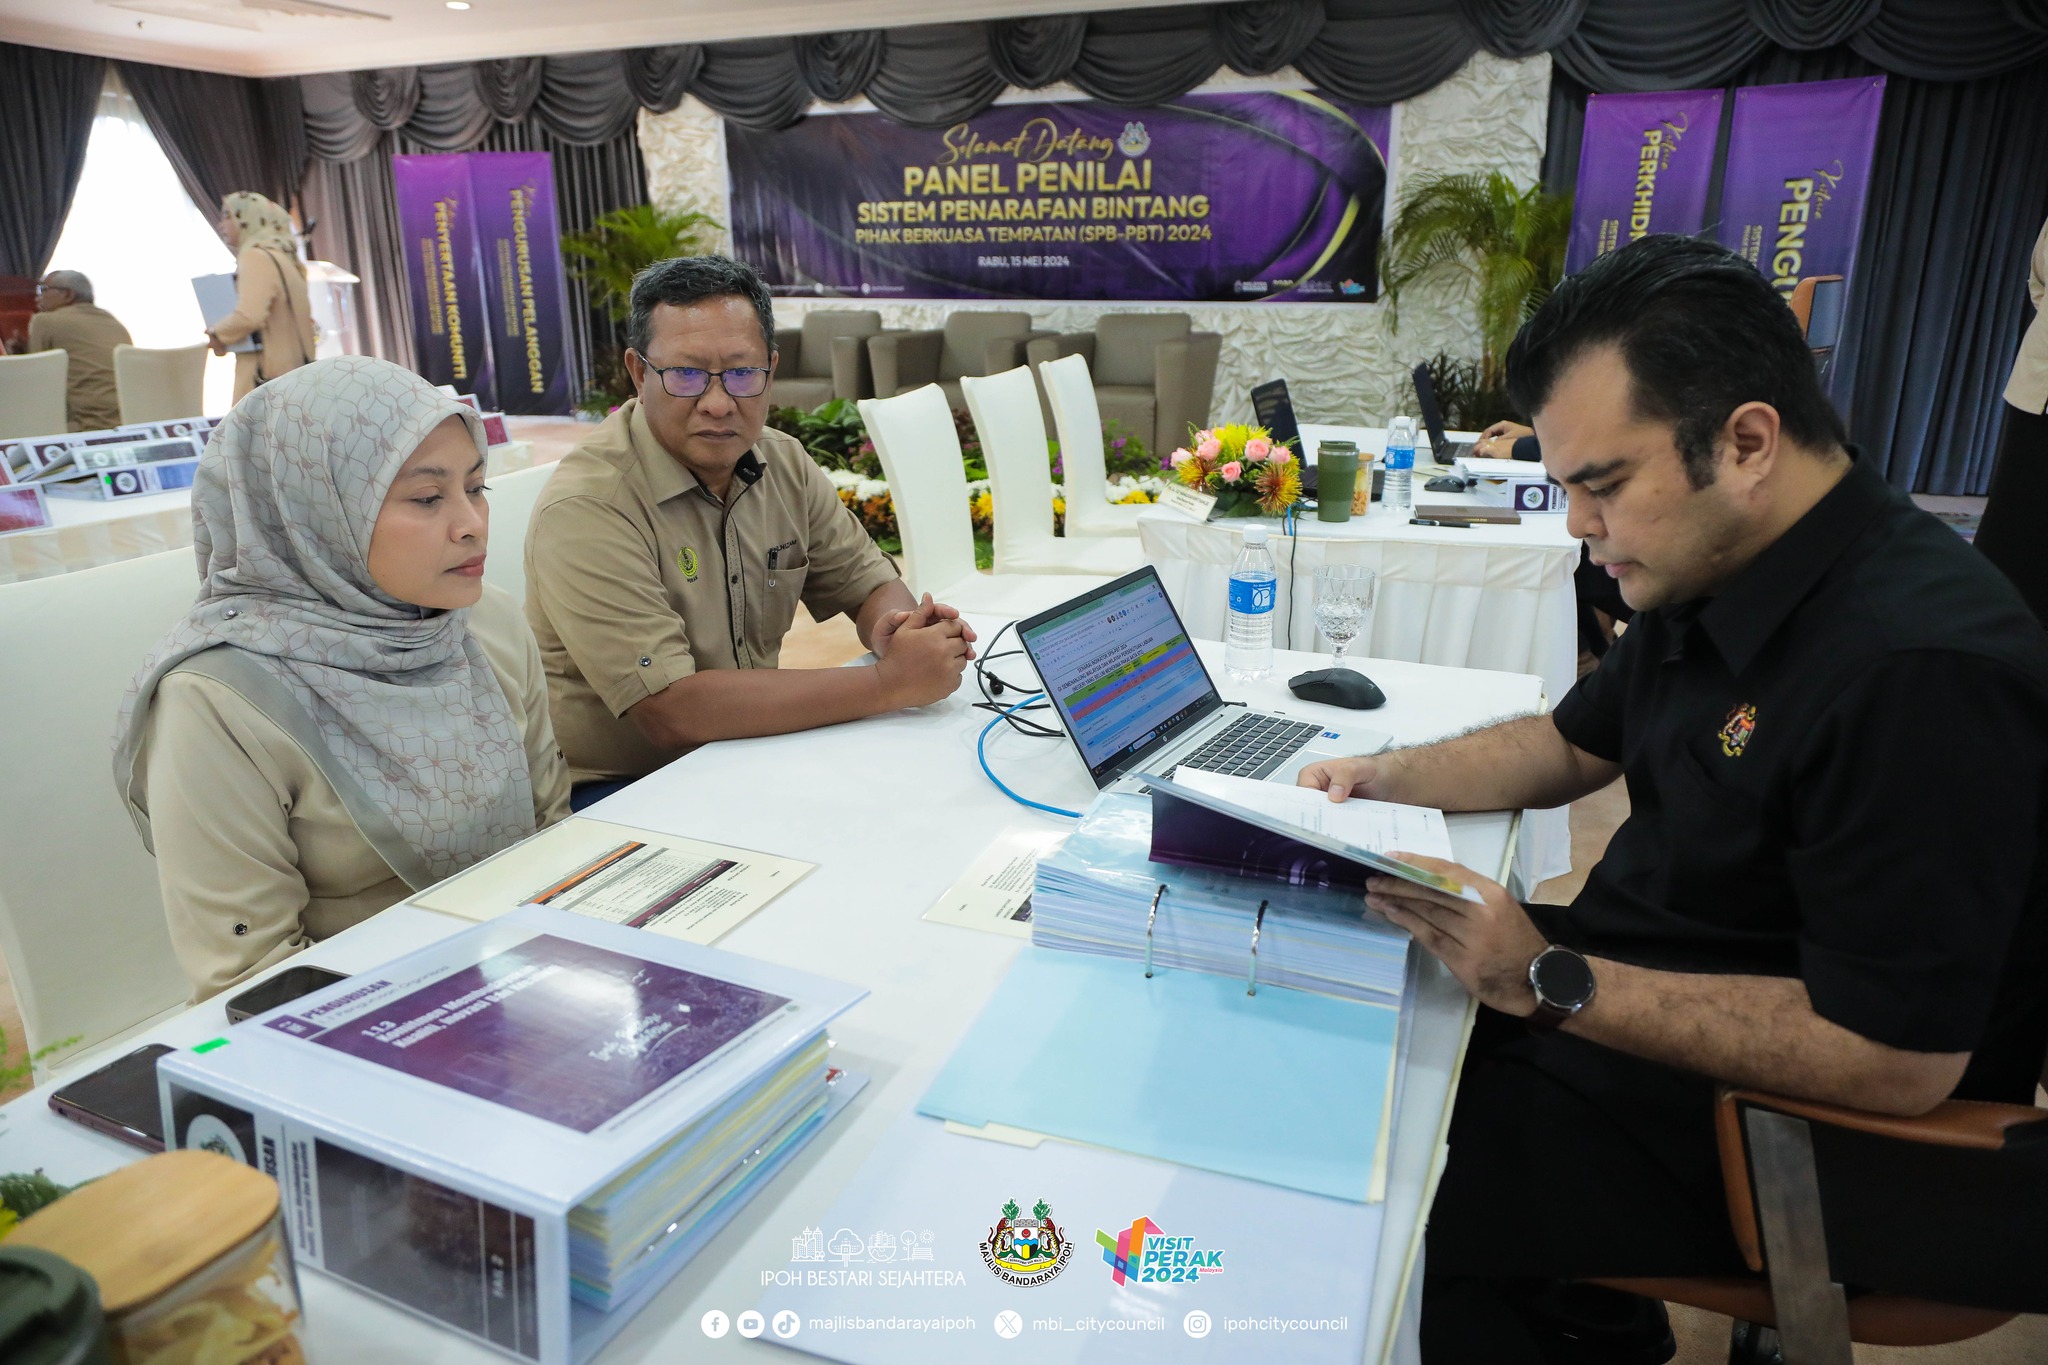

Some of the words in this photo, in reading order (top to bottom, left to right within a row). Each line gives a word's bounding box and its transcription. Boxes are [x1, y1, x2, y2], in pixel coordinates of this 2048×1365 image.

[937, 123, 1031, 165] Selamat
[1024, 117, 1114, 163] Datang
[904, 164, 1010, 196] PANEL
[1017, 159, 1152, 193] PENILAI
[857, 200, 936, 224] SISTEM
[941, 197, 1086, 222] PENARAFAN
[1092, 195, 1210, 219] BINTANG
[855, 228, 900, 243] PIHAK
[903, 227, 985, 243] BERKUASA
[987, 226, 1075, 242] TEMPATAN
[1079, 224, 1164, 243] (SPB-PBT)
[1167, 224, 1212, 241] 2024
[301, 979, 392, 1020] PENGURUSAN
